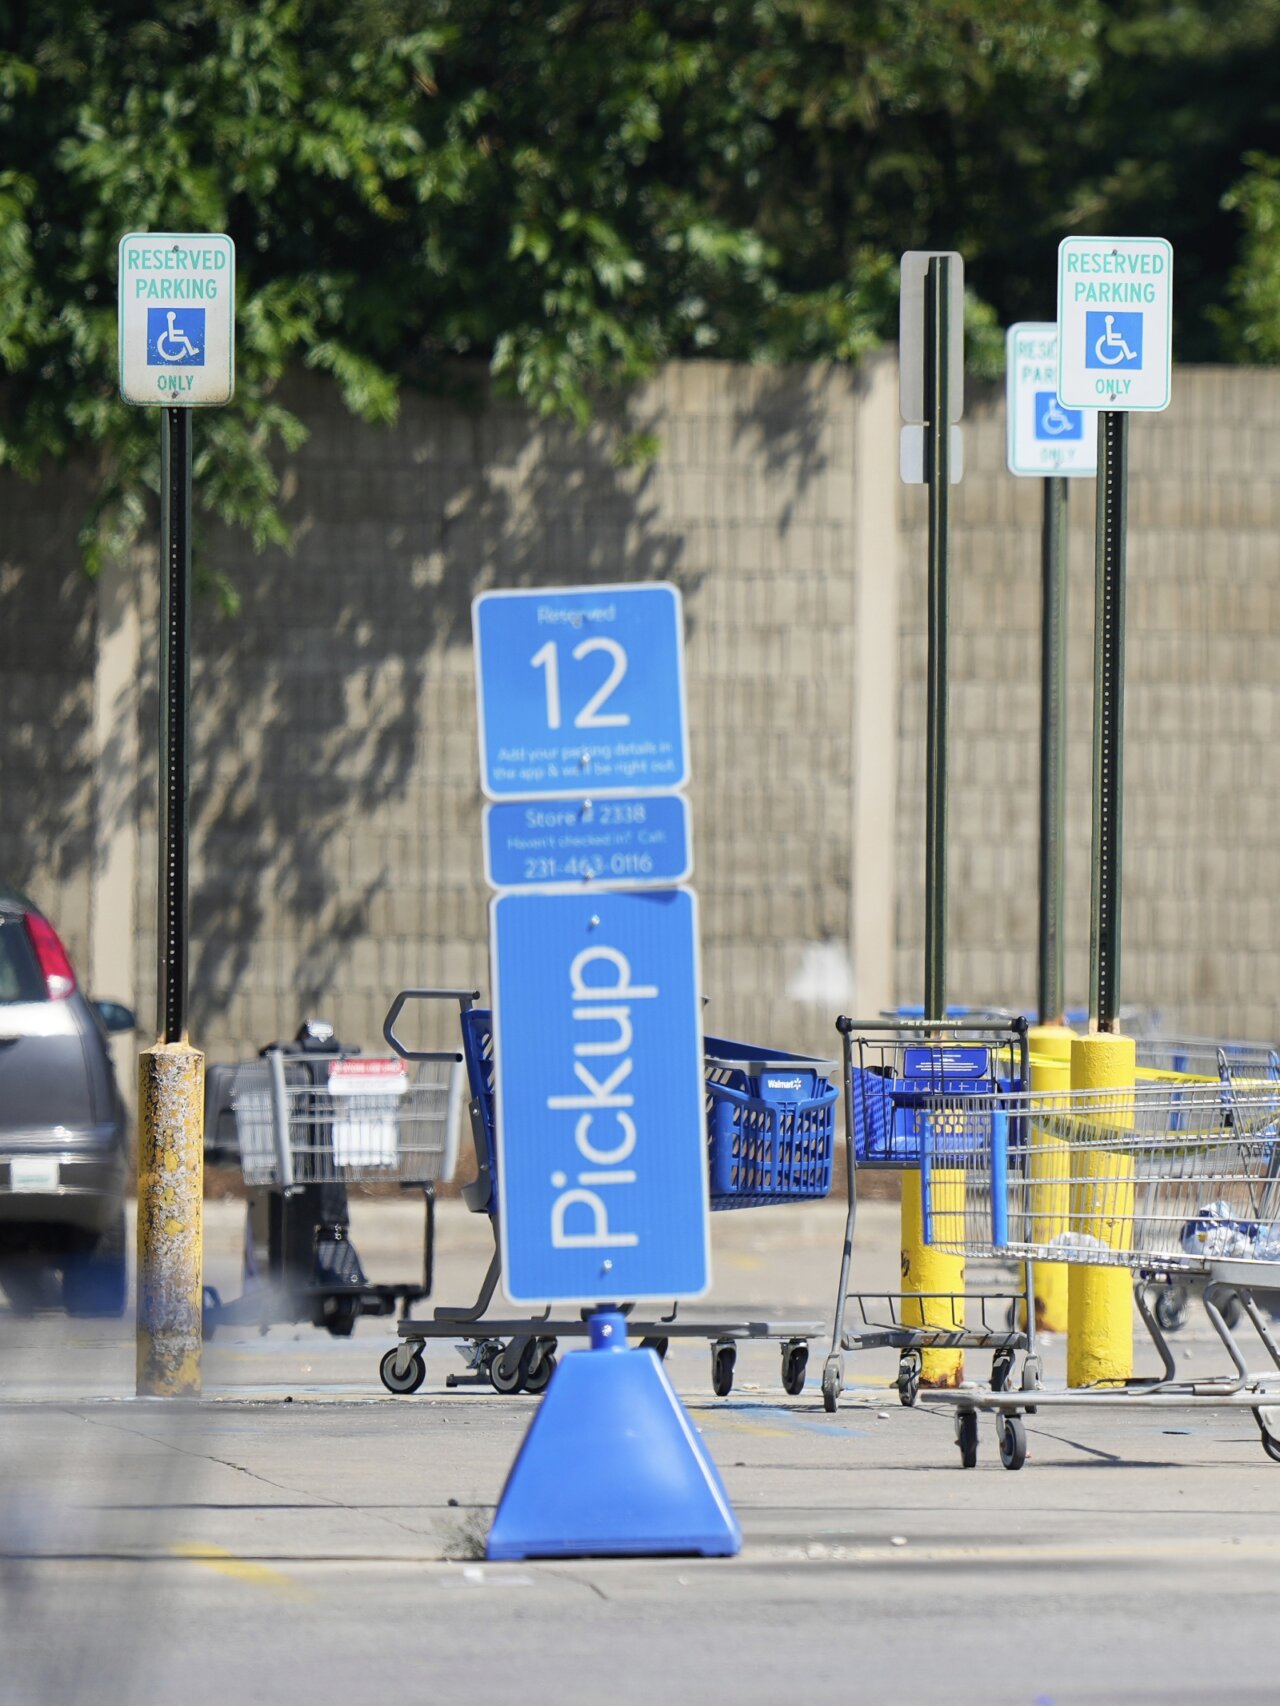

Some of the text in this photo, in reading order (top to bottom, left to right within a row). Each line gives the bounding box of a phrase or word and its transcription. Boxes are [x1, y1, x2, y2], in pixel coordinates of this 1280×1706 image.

[127, 249, 226, 271] RESERVED
[1066, 252, 1164, 275] RESERVED
[135, 278, 218, 300] PARKING
[1074, 281, 1156, 303] PARKING
[157, 374, 195, 392] ONLY
[1095, 378, 1132, 396] ONLY
[1040, 447, 1076, 463] ONLY
[537, 604, 617, 625] Reserved
[530, 636, 631, 729] 12
[525, 808, 577, 829] Store
[600, 804, 647, 825] 2338
[524, 852, 654, 880] 231-463-0116
[768, 1079, 795, 1088] Walmart
[548, 945, 658, 1248] Pickup
